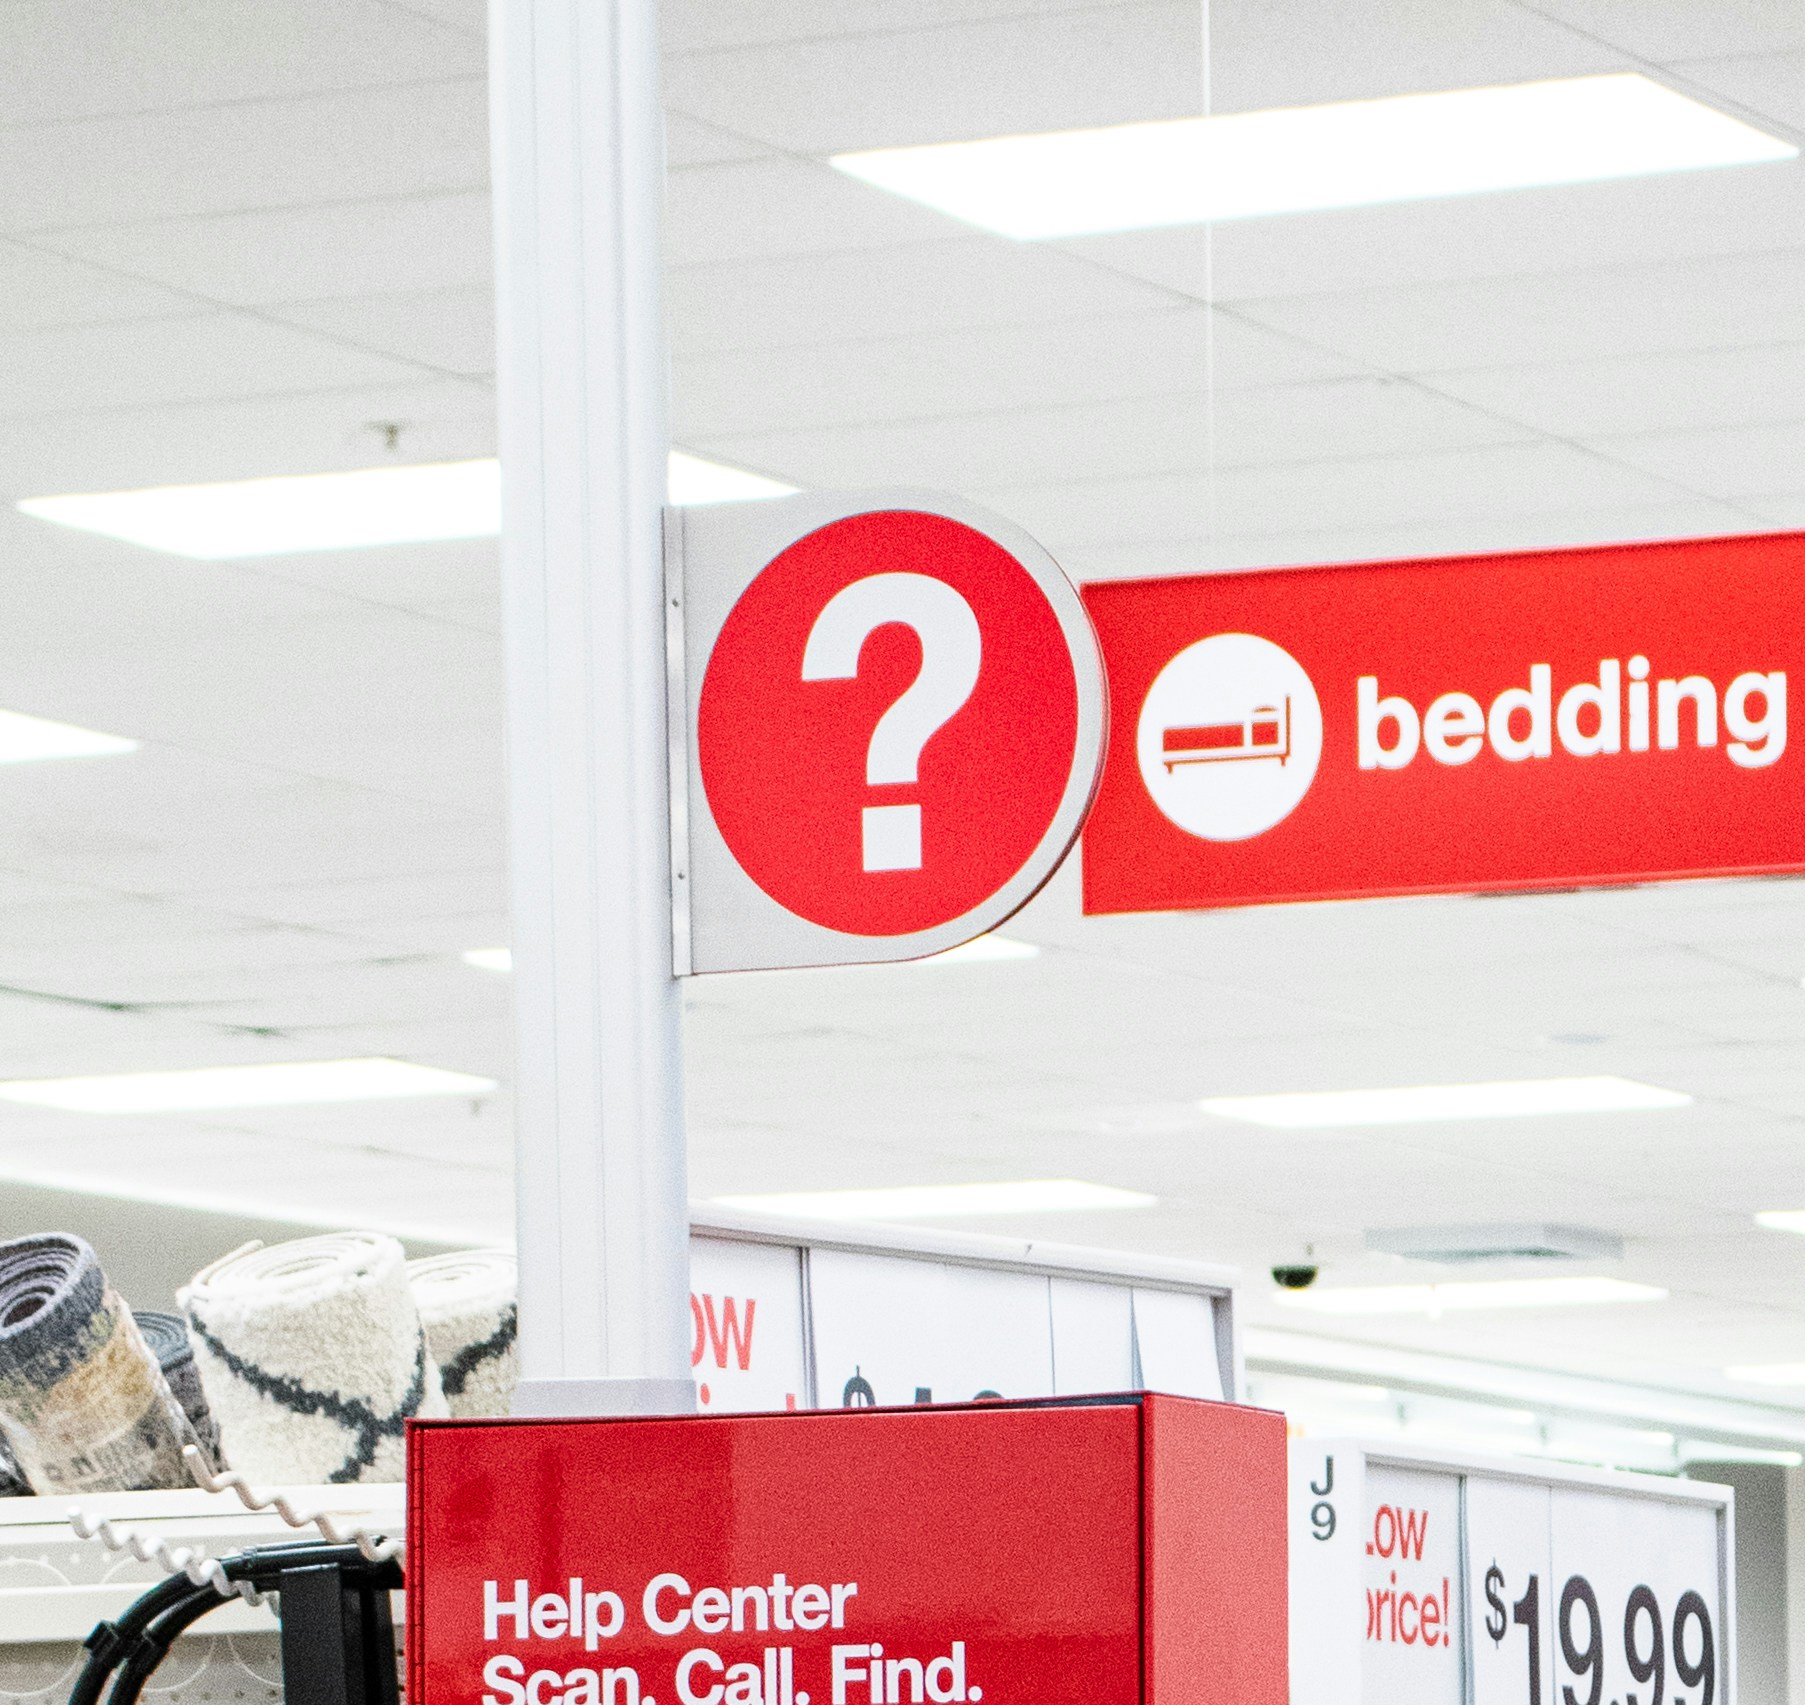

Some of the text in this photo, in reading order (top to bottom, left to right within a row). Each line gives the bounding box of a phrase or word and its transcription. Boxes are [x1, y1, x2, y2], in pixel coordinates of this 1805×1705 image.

[1357, 653, 1788, 769] bedding
[484, 1573, 857, 1651] Help Center
